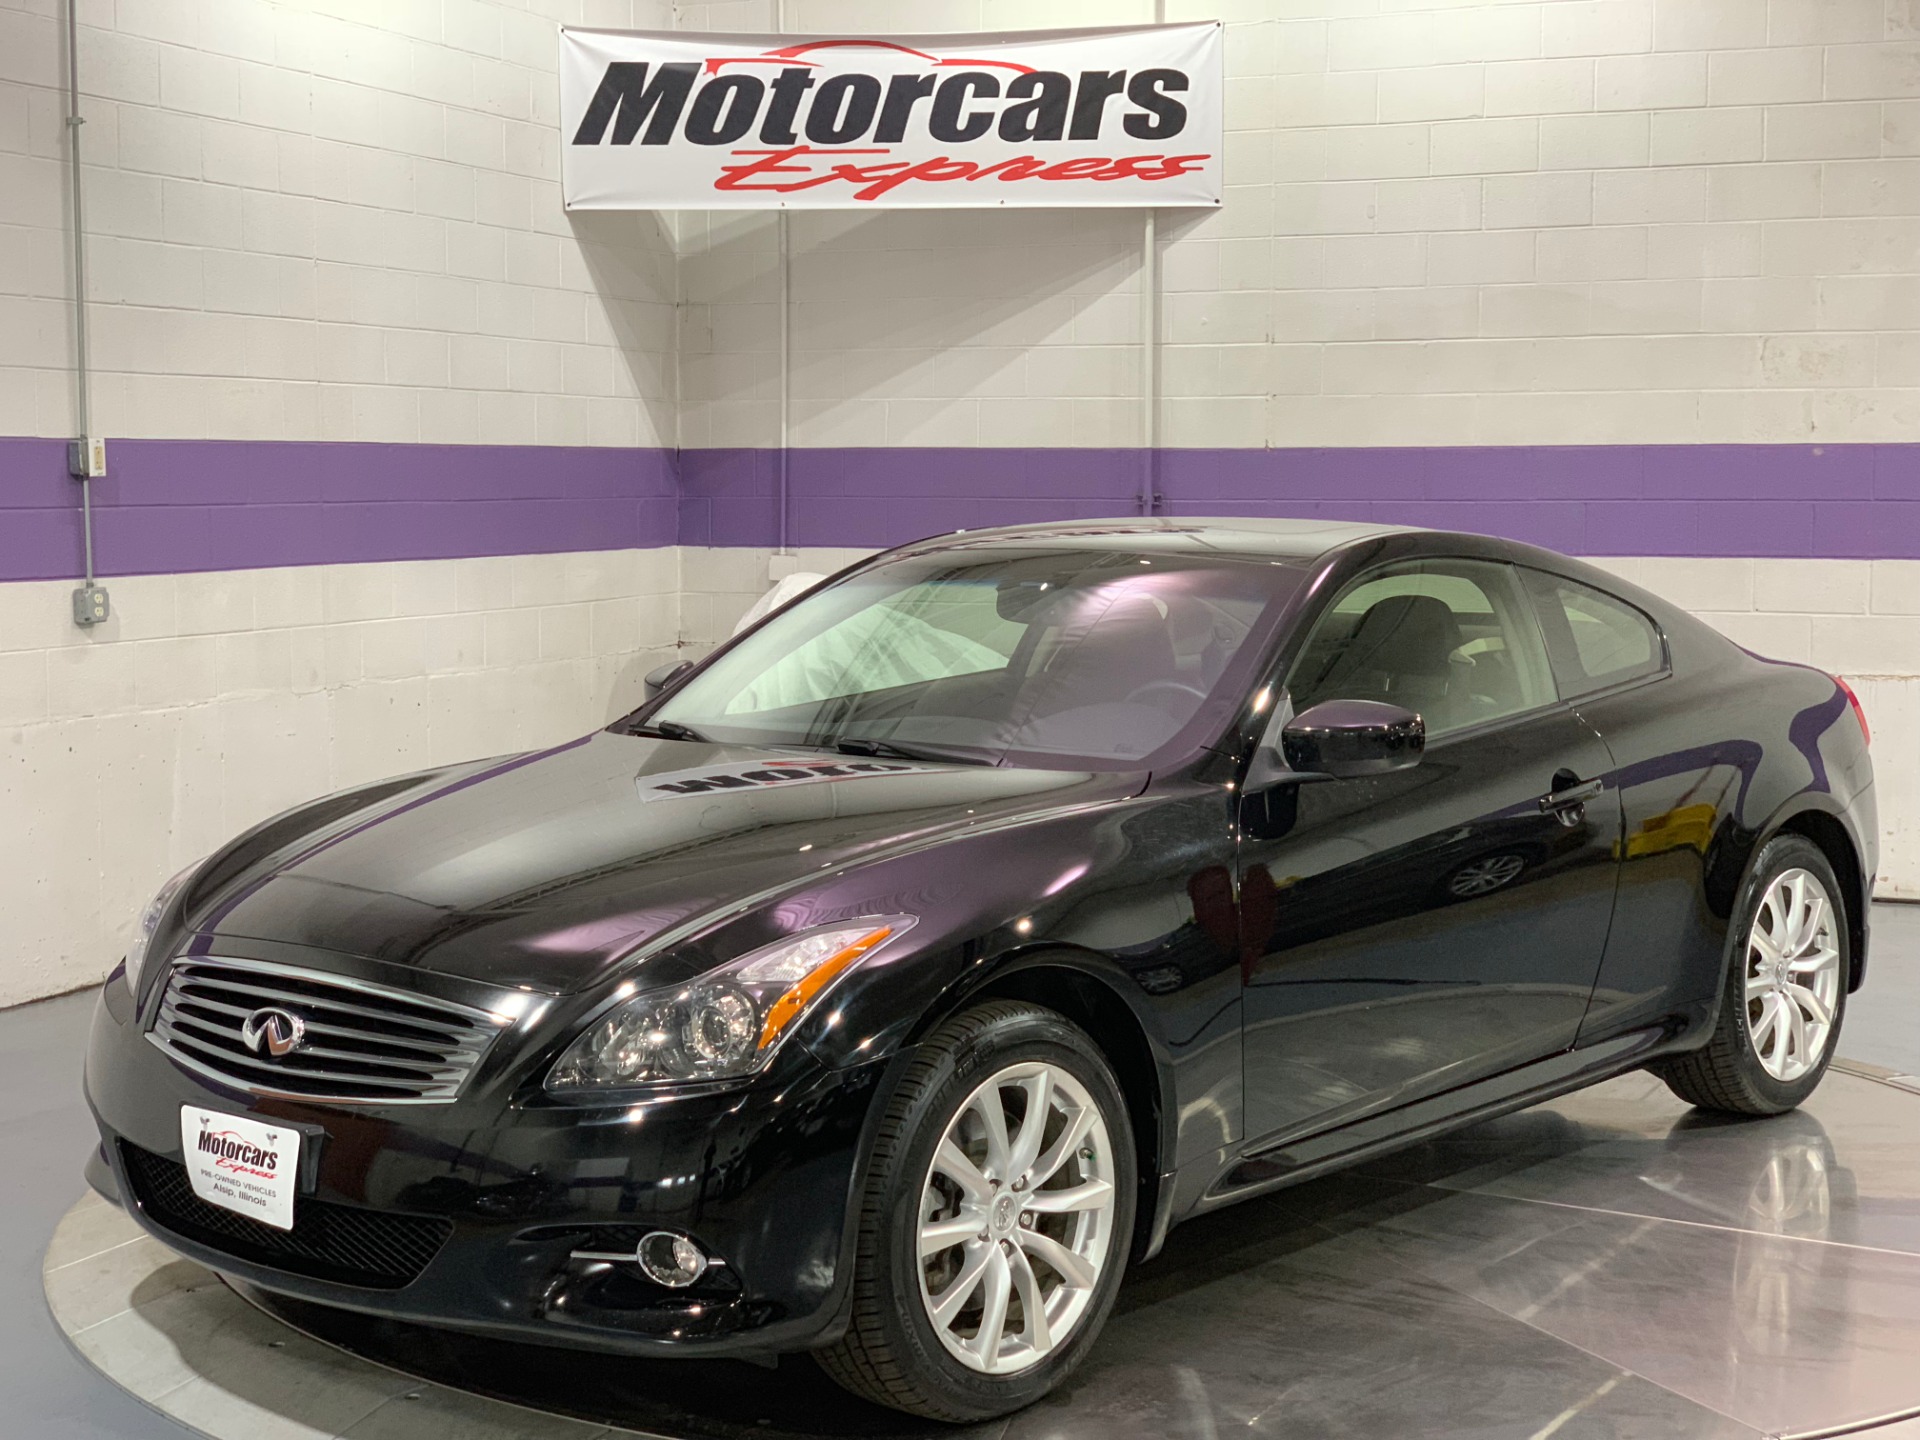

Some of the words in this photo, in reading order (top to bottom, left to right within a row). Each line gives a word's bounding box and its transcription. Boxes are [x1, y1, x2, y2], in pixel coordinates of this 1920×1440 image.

[571, 61, 1190, 145] Motorcars
[713, 145, 1212, 201] Express
[198, 1130, 278, 1170] Motorcars
[200, 1168, 242, 1187] PRE-OWNED
[243, 1181, 277, 1198] VEHICLES
[215, 1157, 278, 1180] Express
[213, 1182, 237, 1198] Alsip,
[238, 1190, 267, 1207] Illinois
